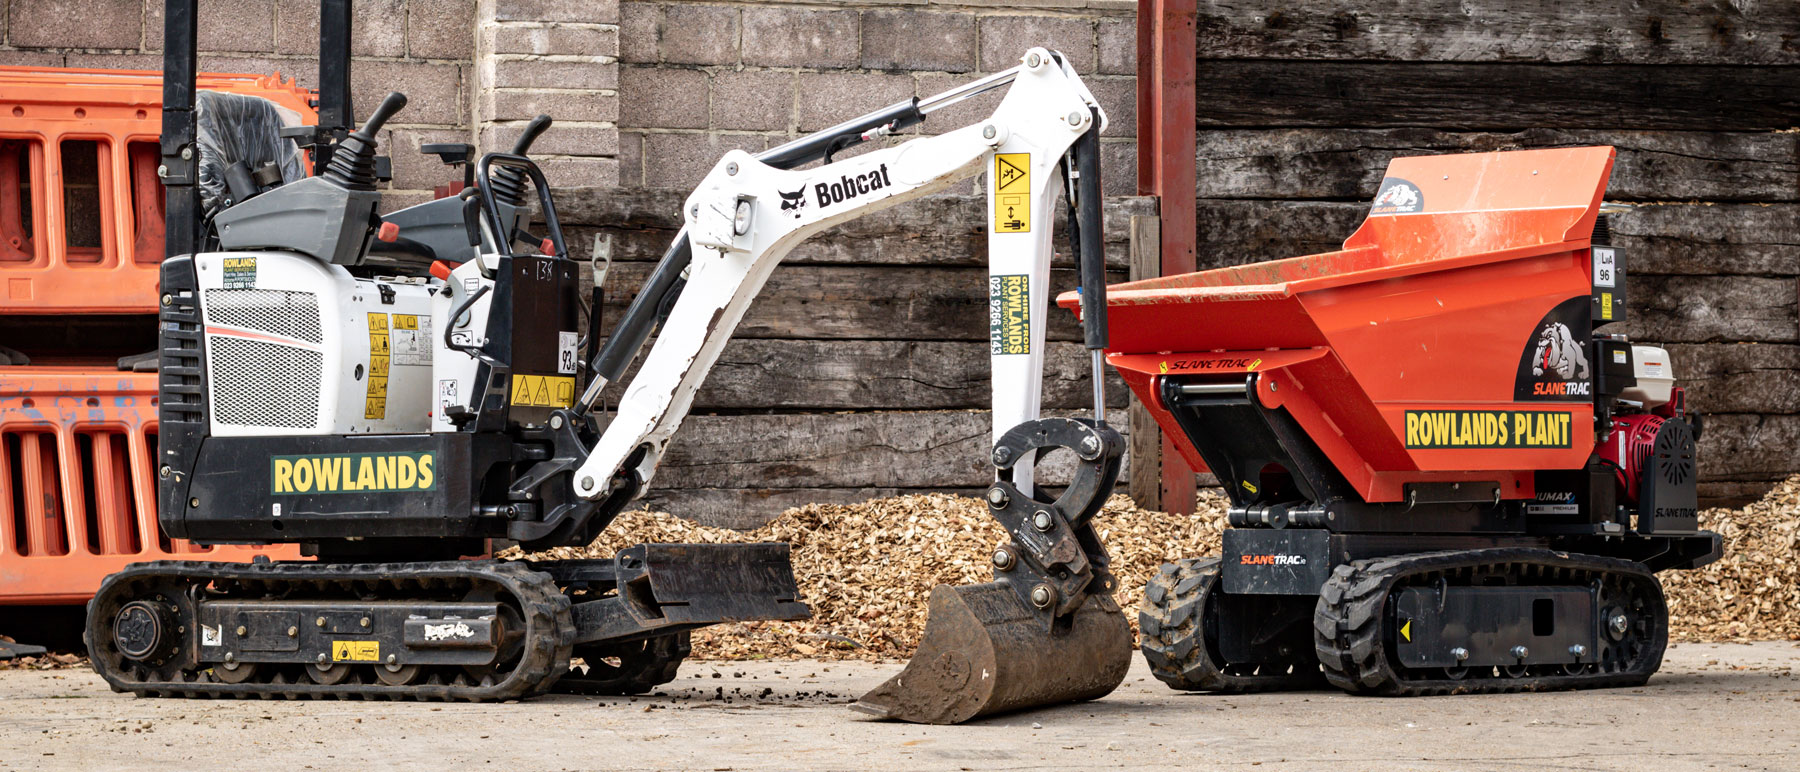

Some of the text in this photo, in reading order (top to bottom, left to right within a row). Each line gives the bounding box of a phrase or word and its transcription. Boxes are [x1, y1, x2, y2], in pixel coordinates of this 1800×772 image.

[814, 163, 891, 208] Bobcat
[224, 258, 256, 268] ROWLANDS
[536, 261, 553, 281] 138
[1022, 276, 1028, 292] ON
[1600, 269, 1610, 281] 96
[991, 277, 1002, 355] 023 9266 1143
[1008, 276, 1022, 354] ROWLANDS
[563, 350, 572, 371] 93
[1533, 382, 1590, 395] SLANETRAC
[1406, 412, 1570, 446] ROWLANDS PLANT
[274, 454, 433, 493] ROWLANDS
